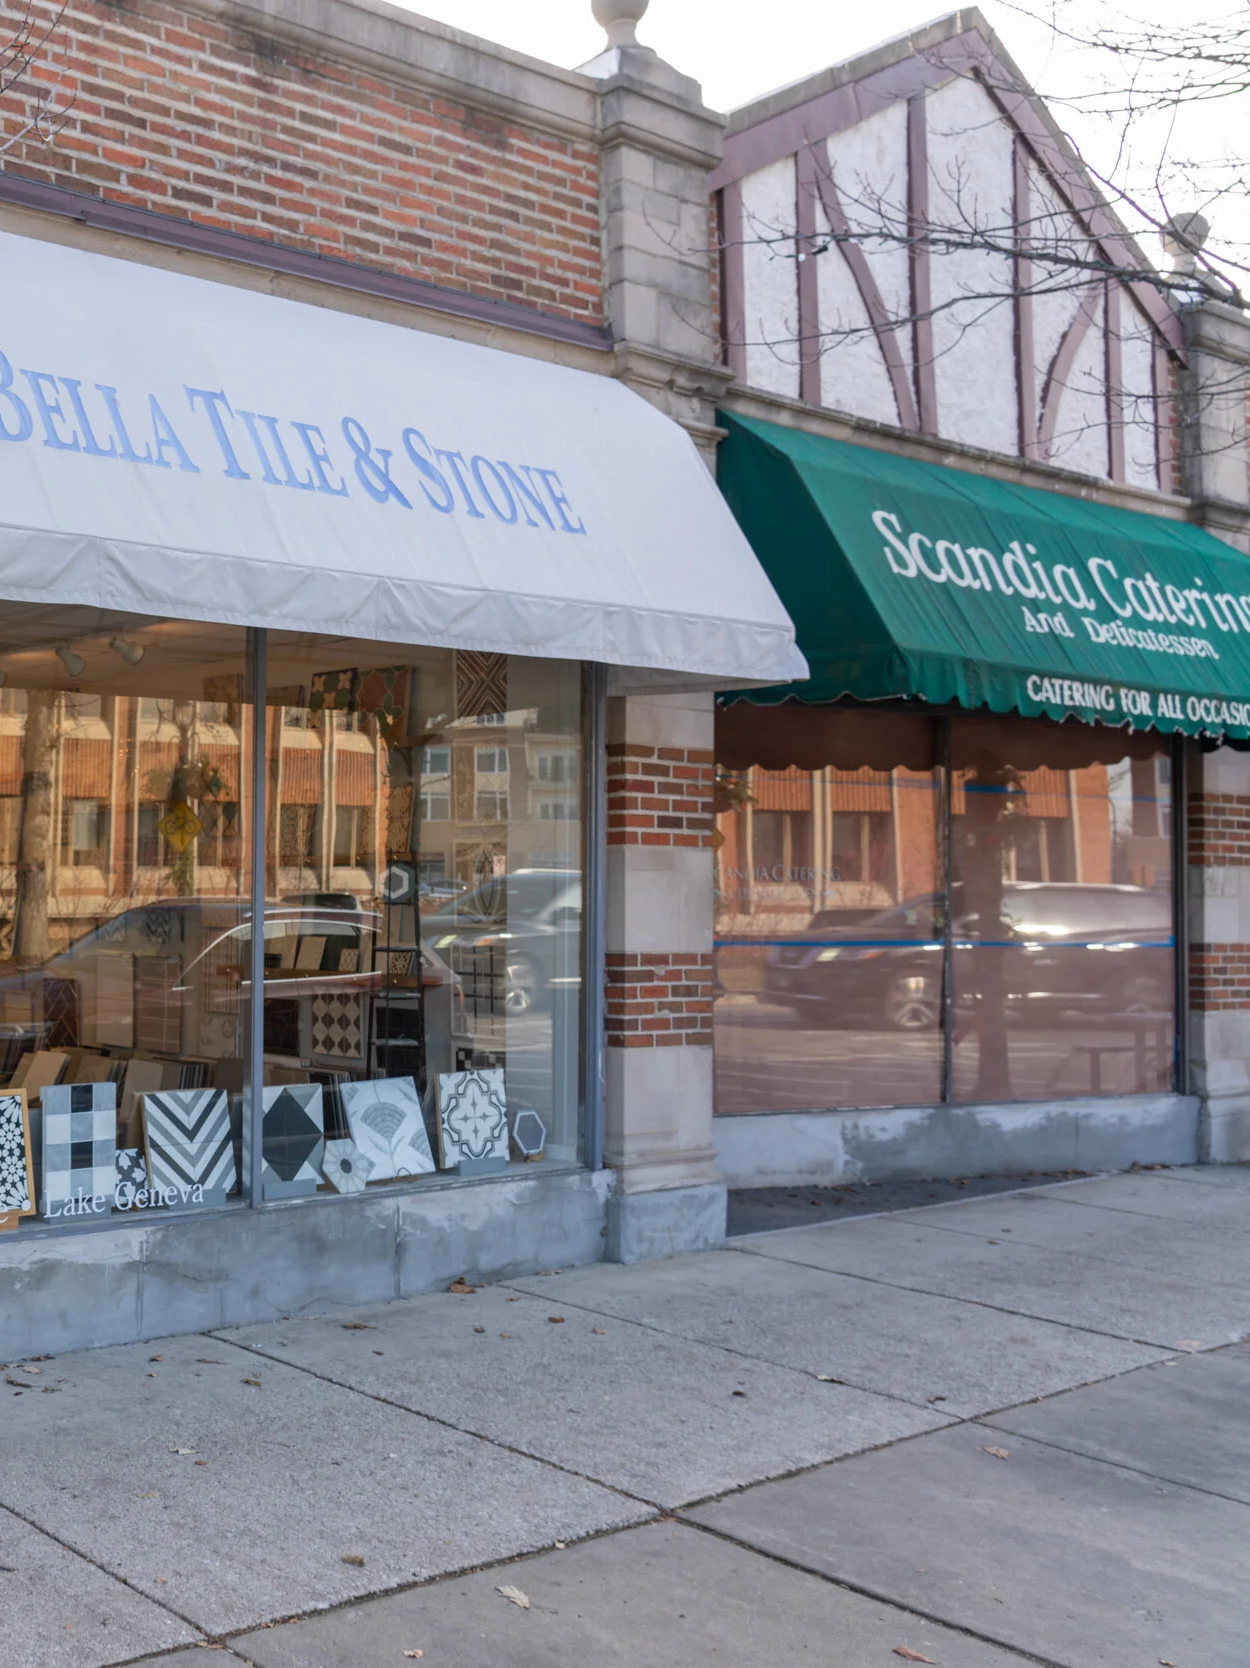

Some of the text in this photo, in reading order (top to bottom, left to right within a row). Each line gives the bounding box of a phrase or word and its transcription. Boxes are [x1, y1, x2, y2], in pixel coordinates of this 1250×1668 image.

[182, 383, 350, 498] TILE
[341, 416, 414, 511] &
[402, 427, 587, 536] STONE
[872, 510, 1097, 612] Scandia
[1021, 605, 1220, 661] And Delicatessen
[1026, 674, 1115, 711] CATERING
[1119, 687, 1153, 716] FOR
[1157, 693, 1184, 720] ALL
[43, 1187, 106, 1218] Lake
[114, 1181, 204, 1211] Geneva
